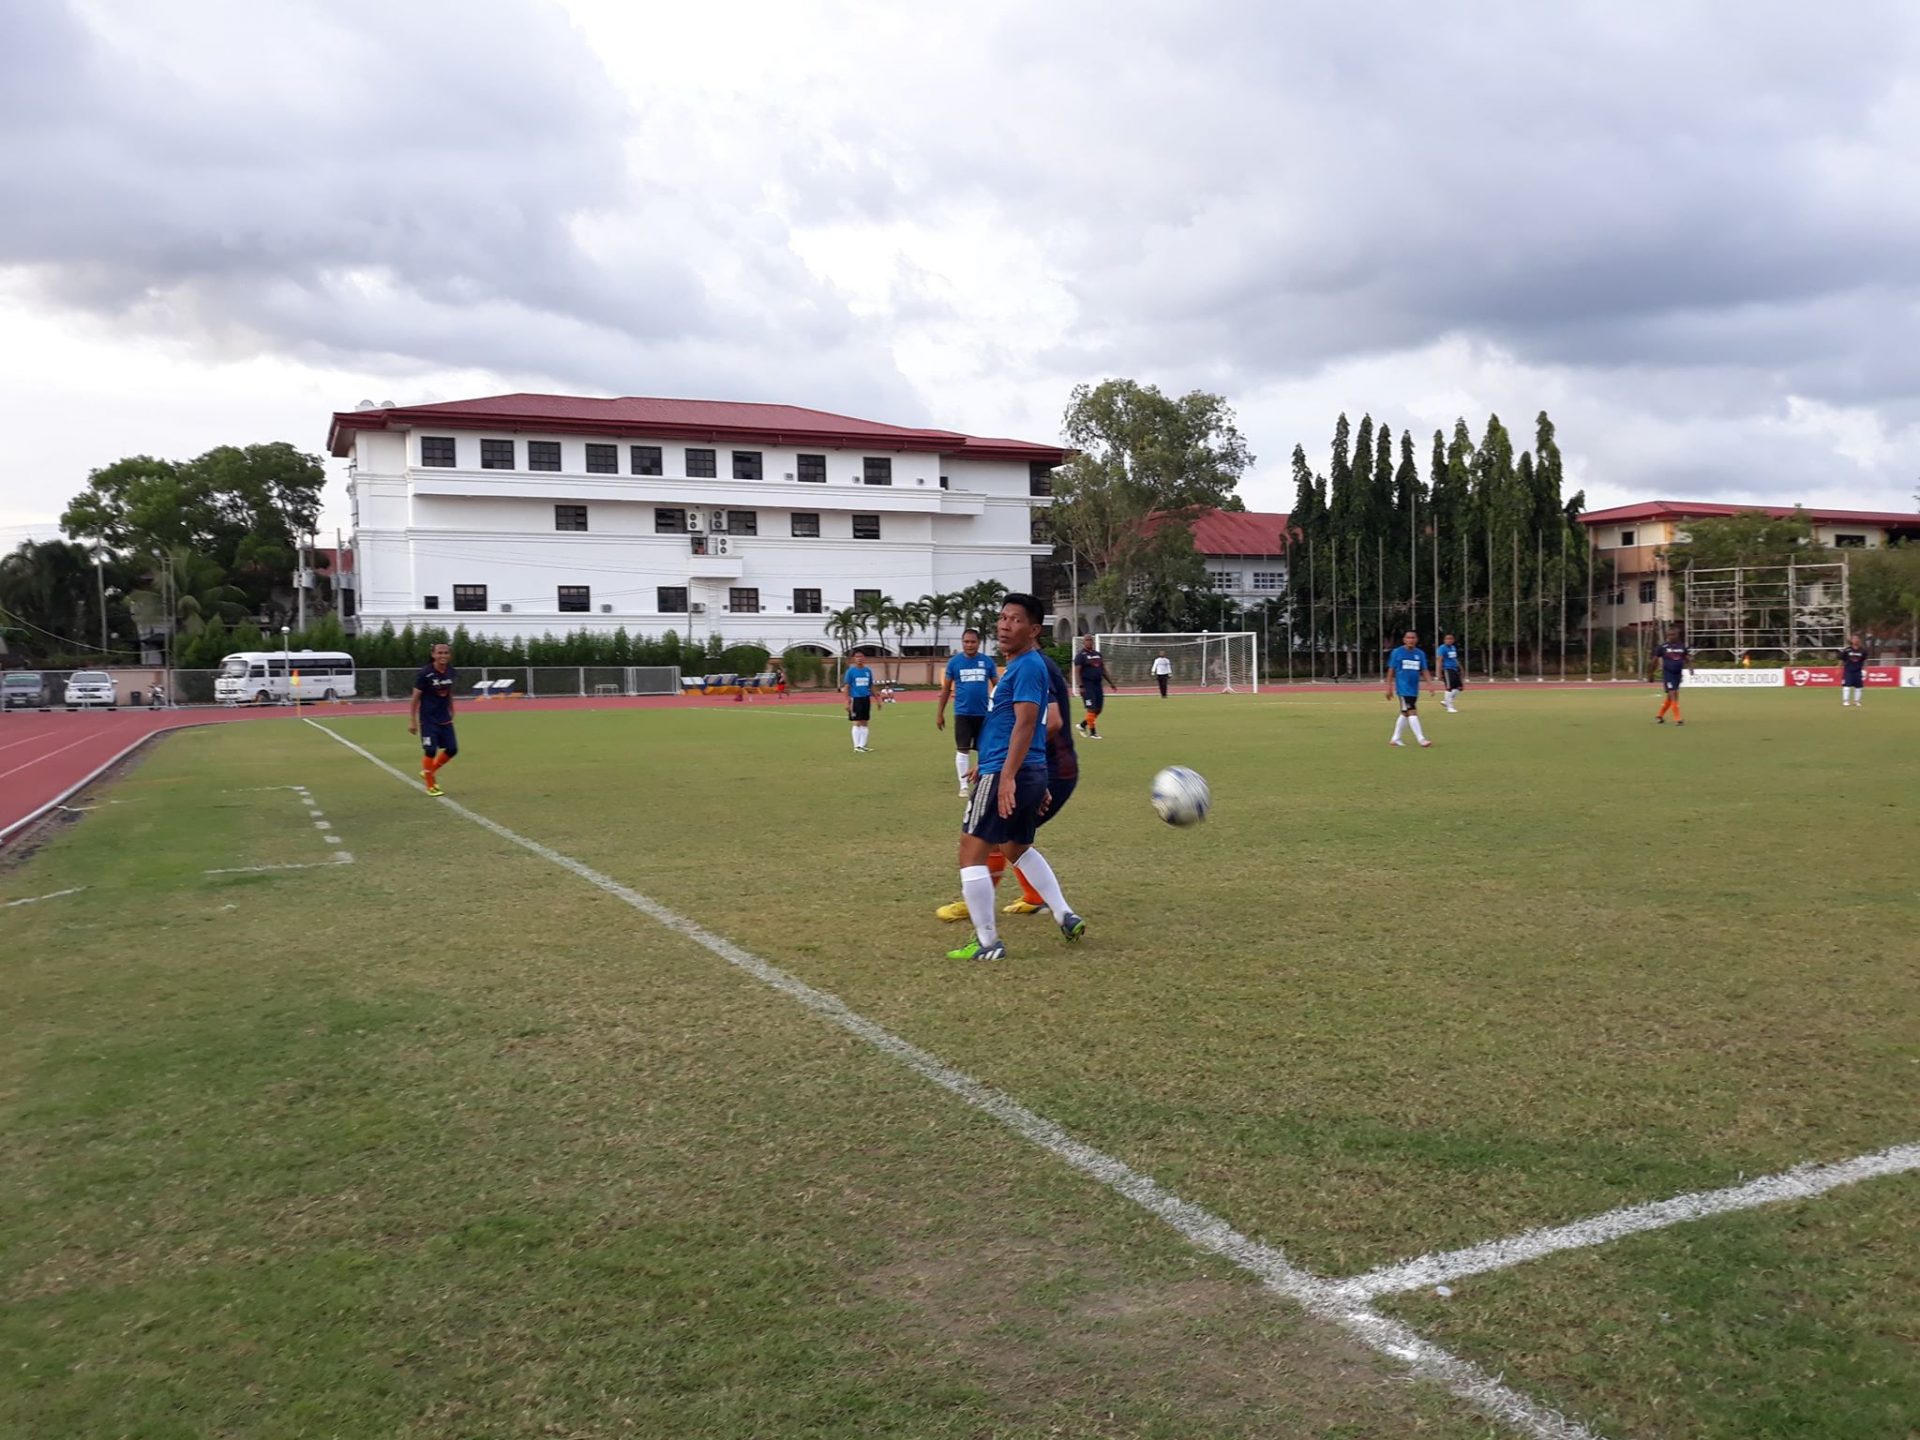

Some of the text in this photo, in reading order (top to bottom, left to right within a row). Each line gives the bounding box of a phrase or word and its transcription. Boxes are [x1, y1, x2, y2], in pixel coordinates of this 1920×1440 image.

[1690, 673, 1778, 684] PROVINCE OF ILOILO
